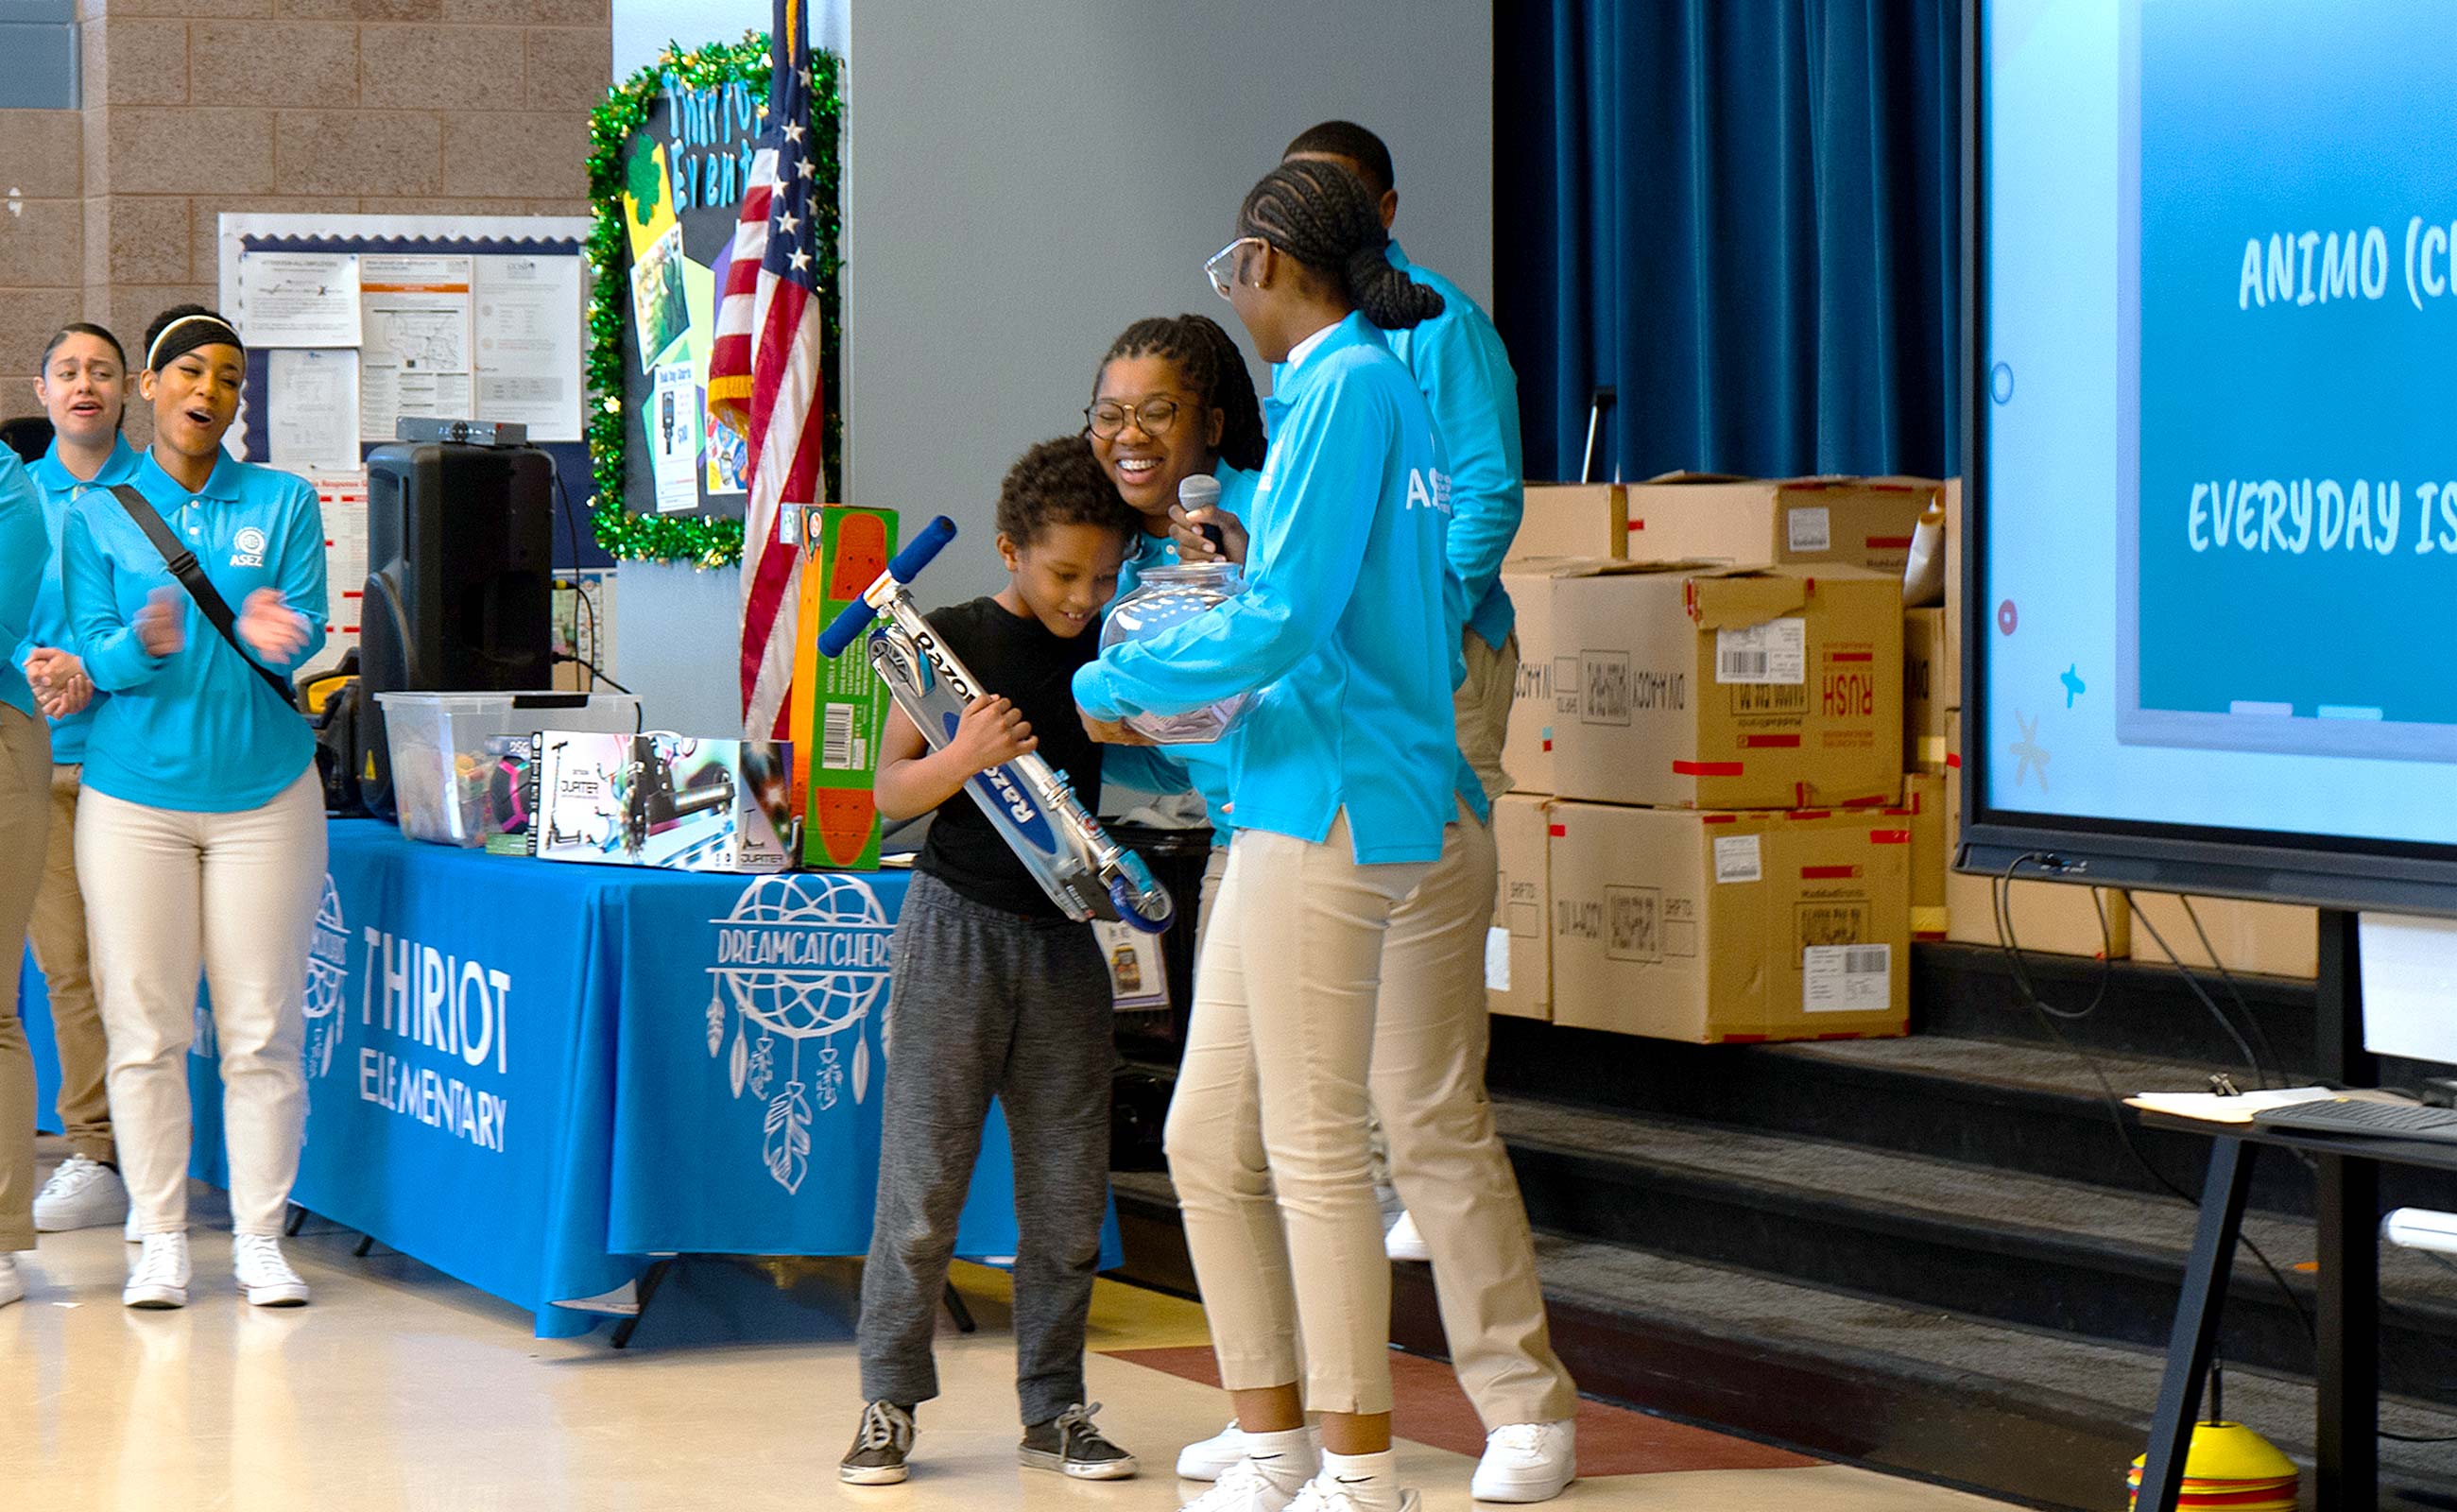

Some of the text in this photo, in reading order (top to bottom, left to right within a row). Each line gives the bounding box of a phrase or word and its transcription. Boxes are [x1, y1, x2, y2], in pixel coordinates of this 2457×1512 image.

[2239, 215, 2457, 312] ANIMO (C
[230, 554, 263, 567] ASEZ
[2188, 477, 2401, 556] EVERYDAY
[1822, 674, 1873, 717] RUSH
[362, 925, 511, 1074] THIRIOT
[359, 1046, 507, 1154] ELEMENTARY
